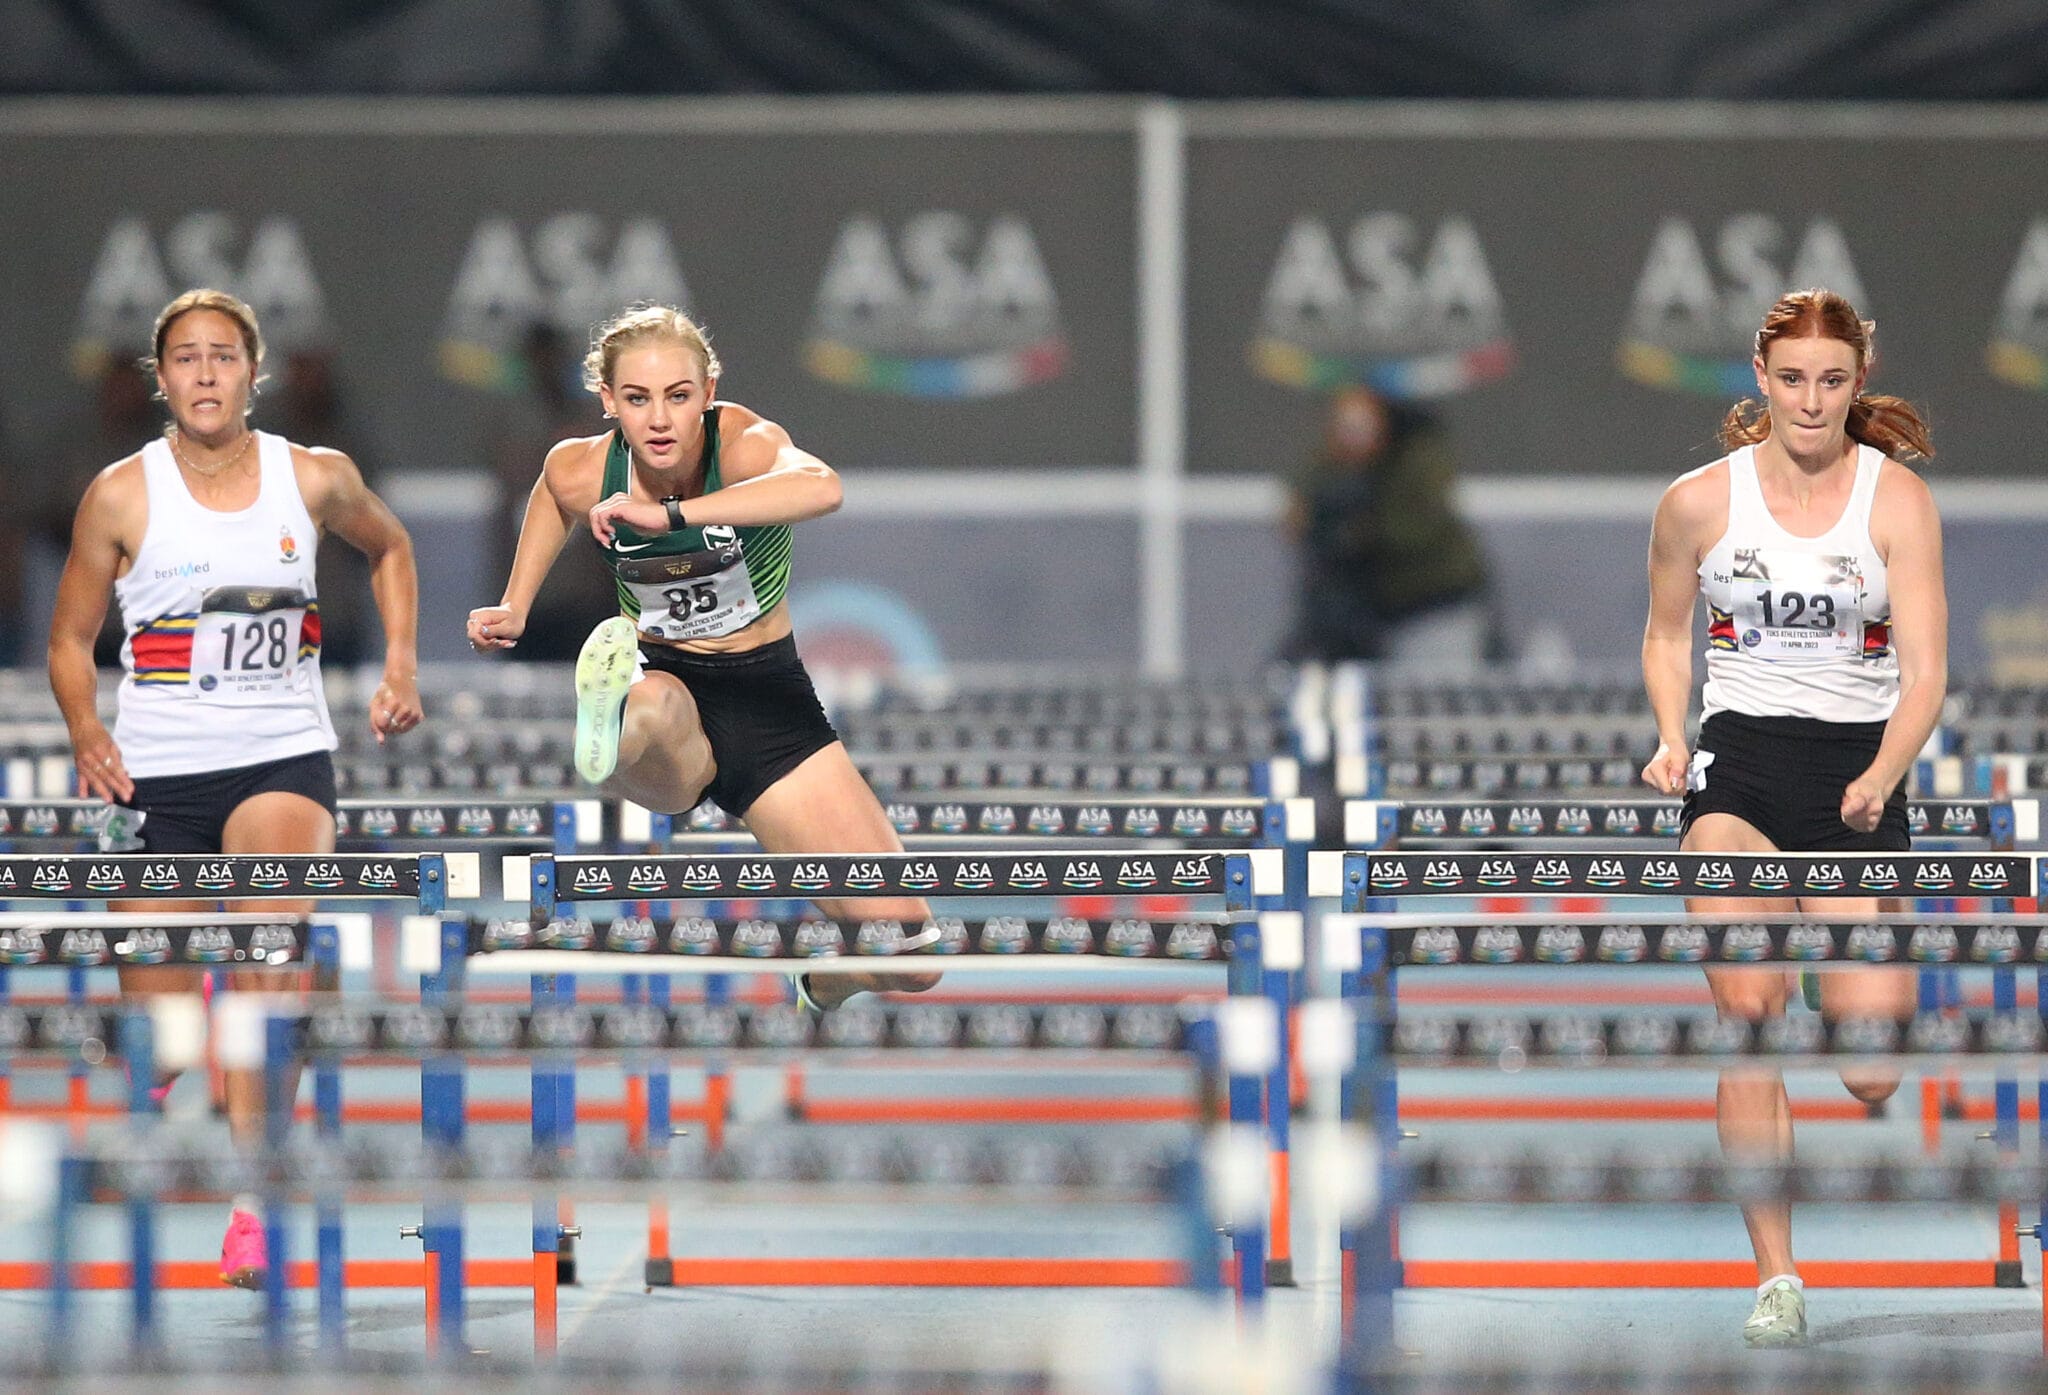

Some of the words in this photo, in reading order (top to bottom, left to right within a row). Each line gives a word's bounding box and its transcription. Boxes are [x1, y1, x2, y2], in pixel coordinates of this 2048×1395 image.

[82, 213, 326, 319] ASA
[455, 213, 697, 319] ASA
[816, 213, 1058, 319] ASA
[1262, 214, 1500, 319] ASA
[155, 561, 210, 579] bestMed
[662, 581, 718, 622] 85
[1757, 590, 1836, 629] 123
[221, 617, 288, 671] 128
[366, 809, 397, 823] ASA
[412, 809, 444, 823] ASA
[460, 809, 492, 823] ASA
[507, 808, 540, 822] ASA
[886, 805, 917, 820] ASA
[933, 806, 966, 820] ASA
[981, 806, 1014, 821] ASA
[1029, 807, 1062, 822] ASA
[1078, 808, 1111, 822] ASA
[1126, 809, 1159, 823] ASA
[1174, 809, 1207, 823] ASA
[1222, 809, 1255, 823] ASA
[1413, 808, 1445, 823] ASA
[1461, 808, 1493, 823] ASA
[1509, 808, 1541, 823] ASA
[1557, 808, 1590, 823] ASA
[1606, 808, 1639, 823] ASA
[1943, 807, 1975, 821] ASA
[33, 865, 69, 881] ASA
[87, 864, 123, 880] ASA
[142, 863, 178, 879] ASA
[196, 862, 234, 878] ASA
[251, 862, 287, 878] ASA
[305, 863, 341, 879] ASA
[359, 863, 396, 879] ASA
[575, 866, 611, 882] ASA
[629, 865, 665, 881] ASA
[683, 864, 719, 880] ASA
[737, 863, 774, 879] ASA
[791, 863, 828, 879] ASA
[846, 863, 883, 879] ASA
[900, 862, 937, 878] ASA
[955, 862, 992, 878] ASA
[1010, 862, 1046, 878] ASA
[1064, 861, 1100, 877] ASA
[1118, 861, 1155, 877] ASA
[1172, 860, 1210, 876] ASA
[1370, 861, 1407, 876] ASA
[1424, 861, 1460, 876] ASA
[1478, 860, 1515, 875] ASA
[1532, 859, 1570, 874] ASA
[1587, 859, 1624, 874] ASA
[1642, 861, 1679, 876] ASA
[1697, 862, 1733, 877] ASA
[1751, 863, 1788, 878] ASA
[1806, 863, 1842, 878] ASA
[1861, 863, 1897, 878] ASA
[1916, 863, 1952, 878] ASA
[1970, 863, 2007, 878] ASA
